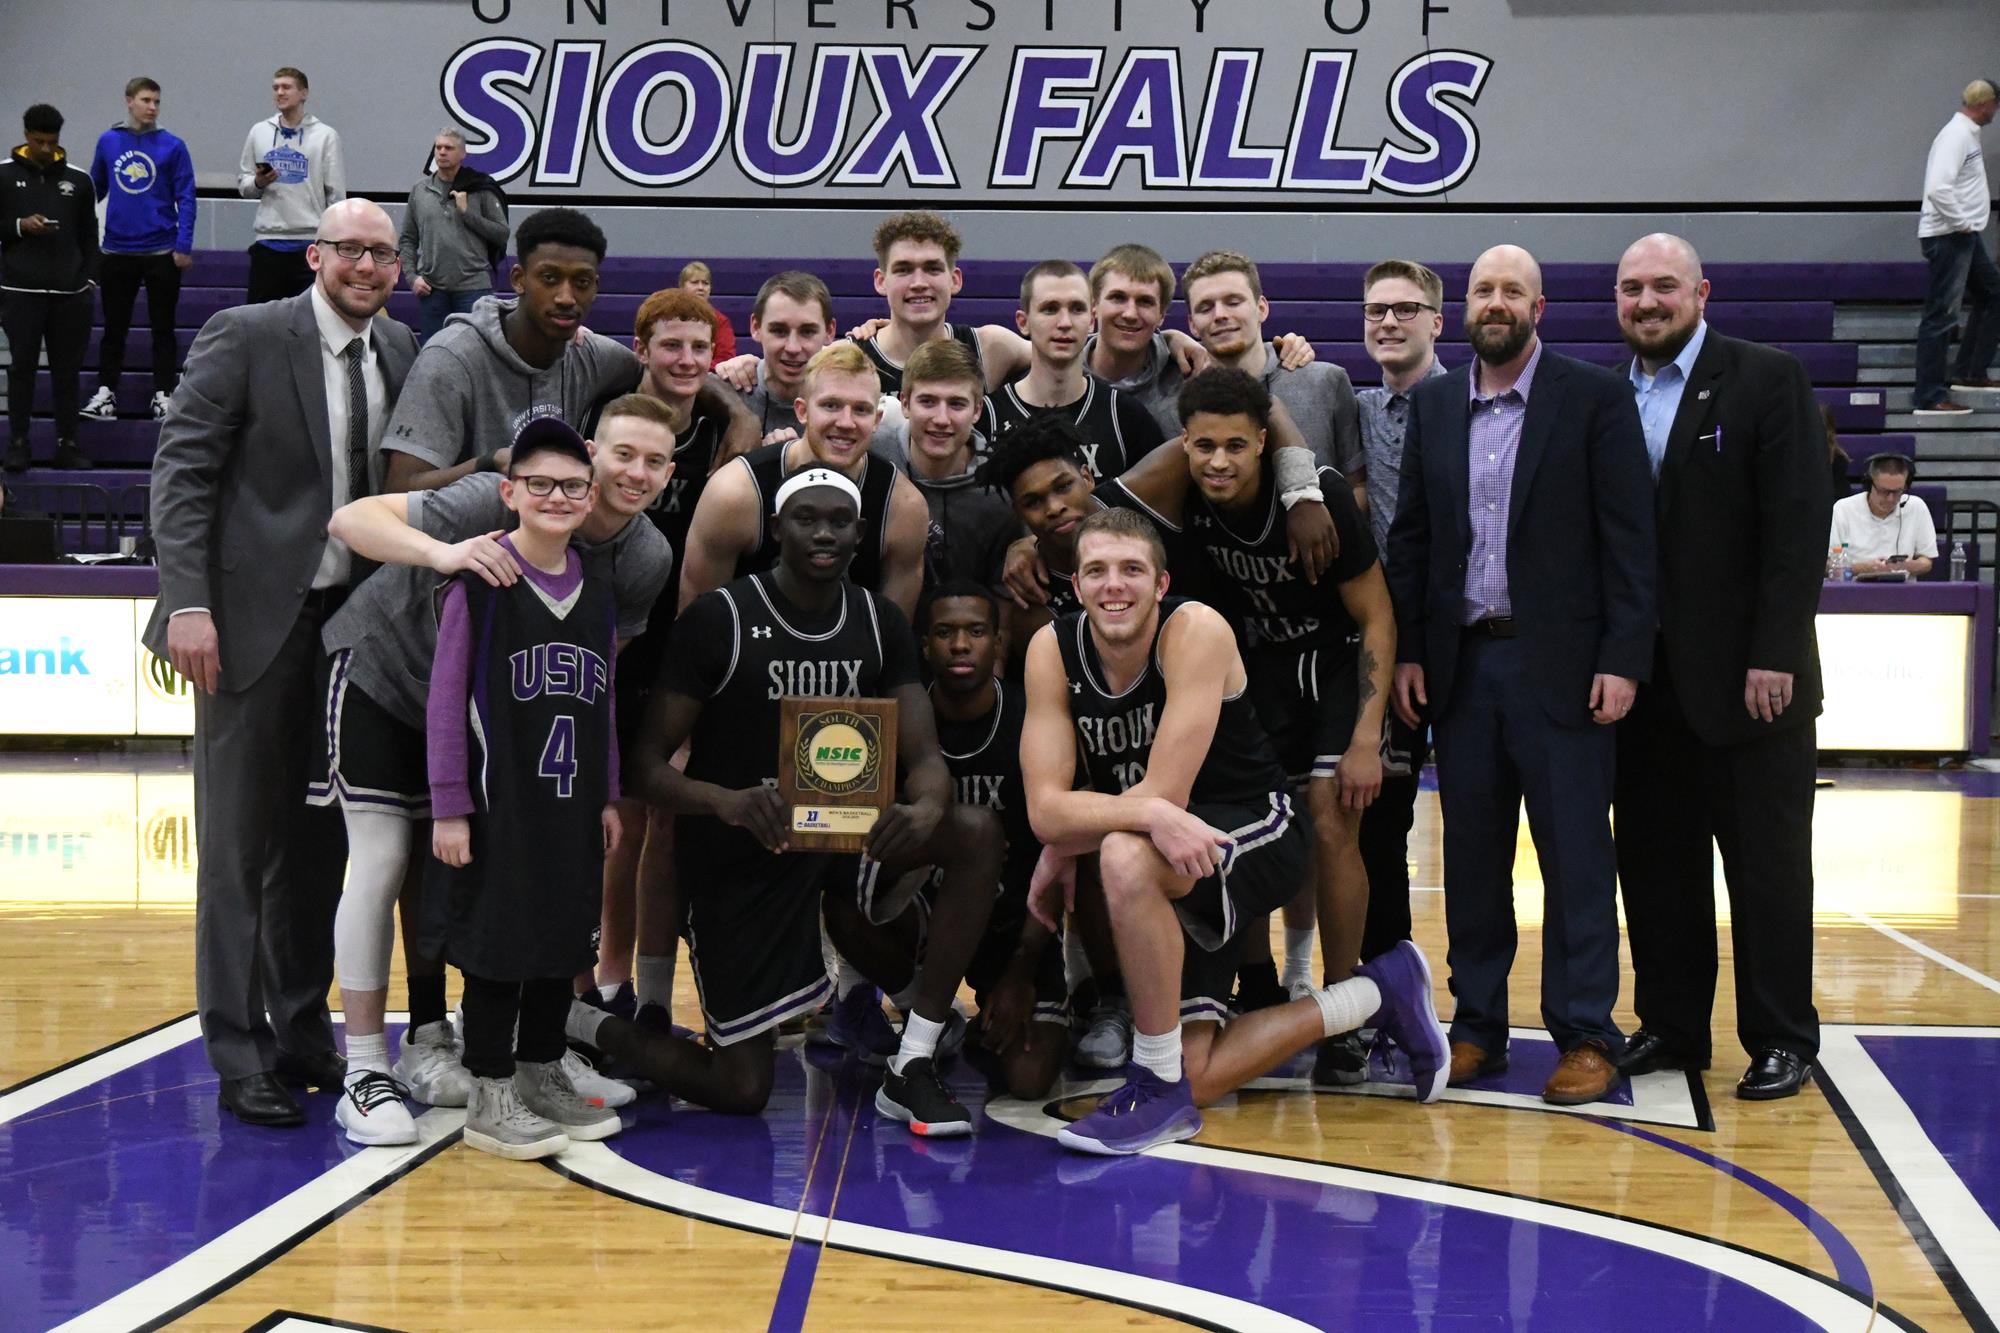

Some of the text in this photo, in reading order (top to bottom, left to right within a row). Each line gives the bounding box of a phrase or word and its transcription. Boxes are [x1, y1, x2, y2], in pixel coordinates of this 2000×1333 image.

[1324, 0, 1450, 36] OF
[424, 36, 1494, 197] SIOUX FALLS
[509, 642, 607, 704] USF
[768, 660, 862, 700] SIOUX
[819, 713, 859, 728] SOUTH
[1078, 703, 1155, 755] SIOUX
[538, 715, 577, 797] 4
[815, 746, 863, 761] NSIC
[814, 777, 861, 793] CHAMPION
